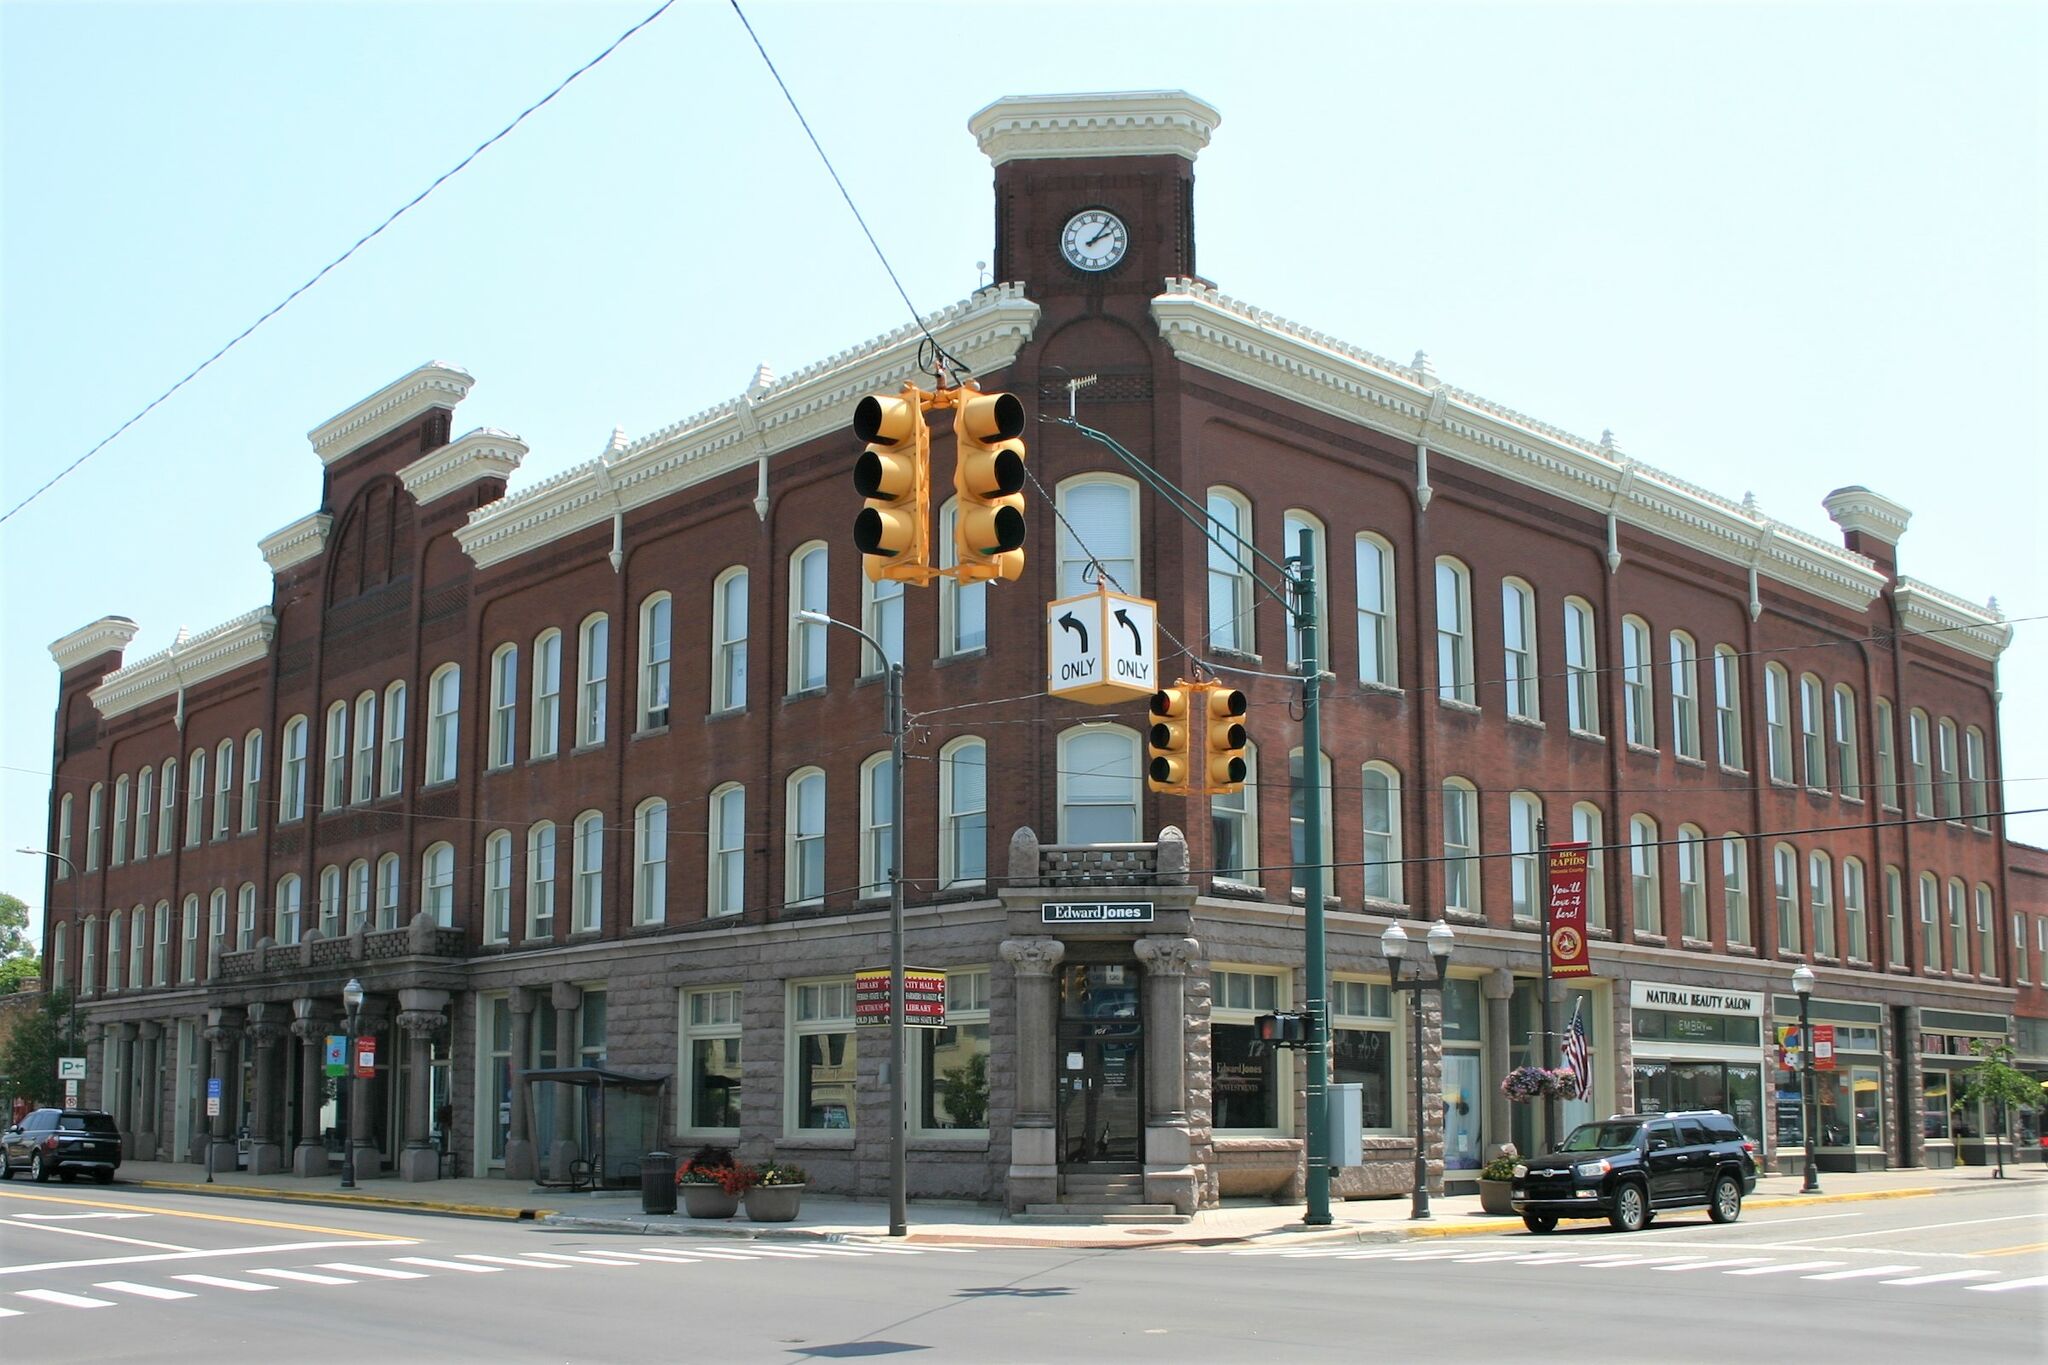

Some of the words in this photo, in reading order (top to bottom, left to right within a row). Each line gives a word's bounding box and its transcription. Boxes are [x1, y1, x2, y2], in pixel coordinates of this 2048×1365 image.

[1061, 657, 1096, 681] ONLY
[1117, 658, 1149, 680] ONLY
[1551, 856, 1585, 867] RAPIDS
[1552, 881, 1581, 895] You'll
[1055, 905, 1101, 919] Edward
[1101, 905, 1142, 920] Jones
[1556, 907, 1578, 919] here!
[857, 982, 879, 990] LIBRARY
[919, 982, 935, 990] HALL
[1646, 989, 1688, 1006] NATURAL
[1690, 993, 1723, 1009] BEAUTY
[1724, 996, 1752, 1011] SALON
[906, 1004, 931, 1012] LIBRARY
[857, 1016, 868, 1024] OLD
[869, 1015, 880, 1024] JAIL
[62, 1061, 74, 1076] P
[1242, 1063, 1263, 1075] Jones
